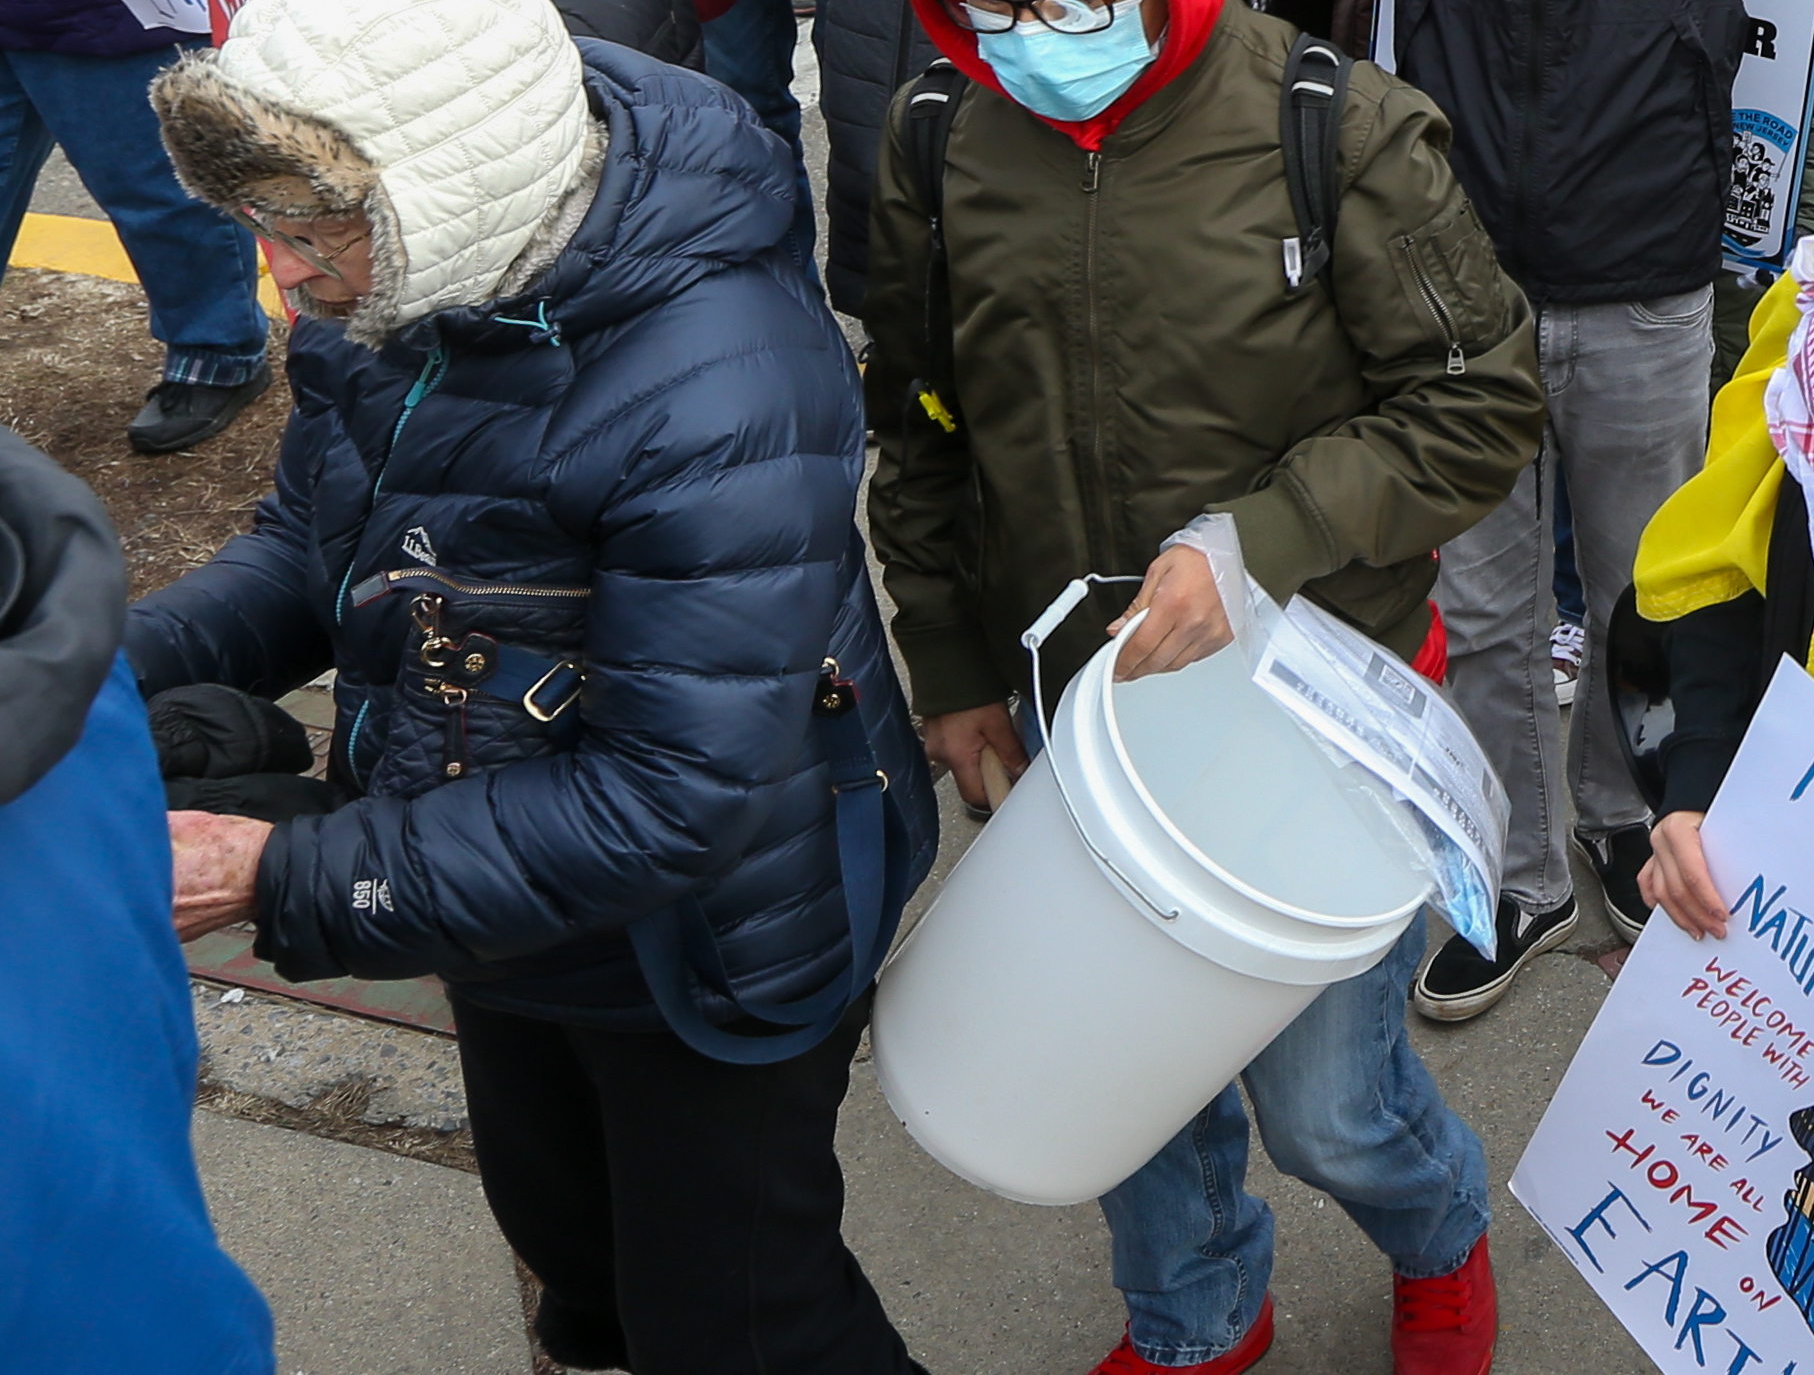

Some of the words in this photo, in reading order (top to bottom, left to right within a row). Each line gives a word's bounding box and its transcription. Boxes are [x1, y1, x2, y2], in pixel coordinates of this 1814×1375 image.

[1743, 16, 1777, 61] R
[1738, 111, 1761, 123] THE
[1762, 116, 1794, 140] ROAD
[1756, 125, 1789, 147] JERSEY
[352, 880, 371, 909] 850
[1680, 977, 1759, 1049] PEOPLE
[1762, 1043, 1812, 1091] WITH
[1641, 1088, 1679, 1124] WE
[1680, 1133, 1730, 1172] ARE
[1729, 1177, 1764, 1214] ALL
[1642, 1039, 1784, 1164] DIGNITY
[1605, 1128, 1749, 1252] HOME
[1738, 1276, 1782, 1312] ON
[1563, 1180, 1797, 1375] EART
